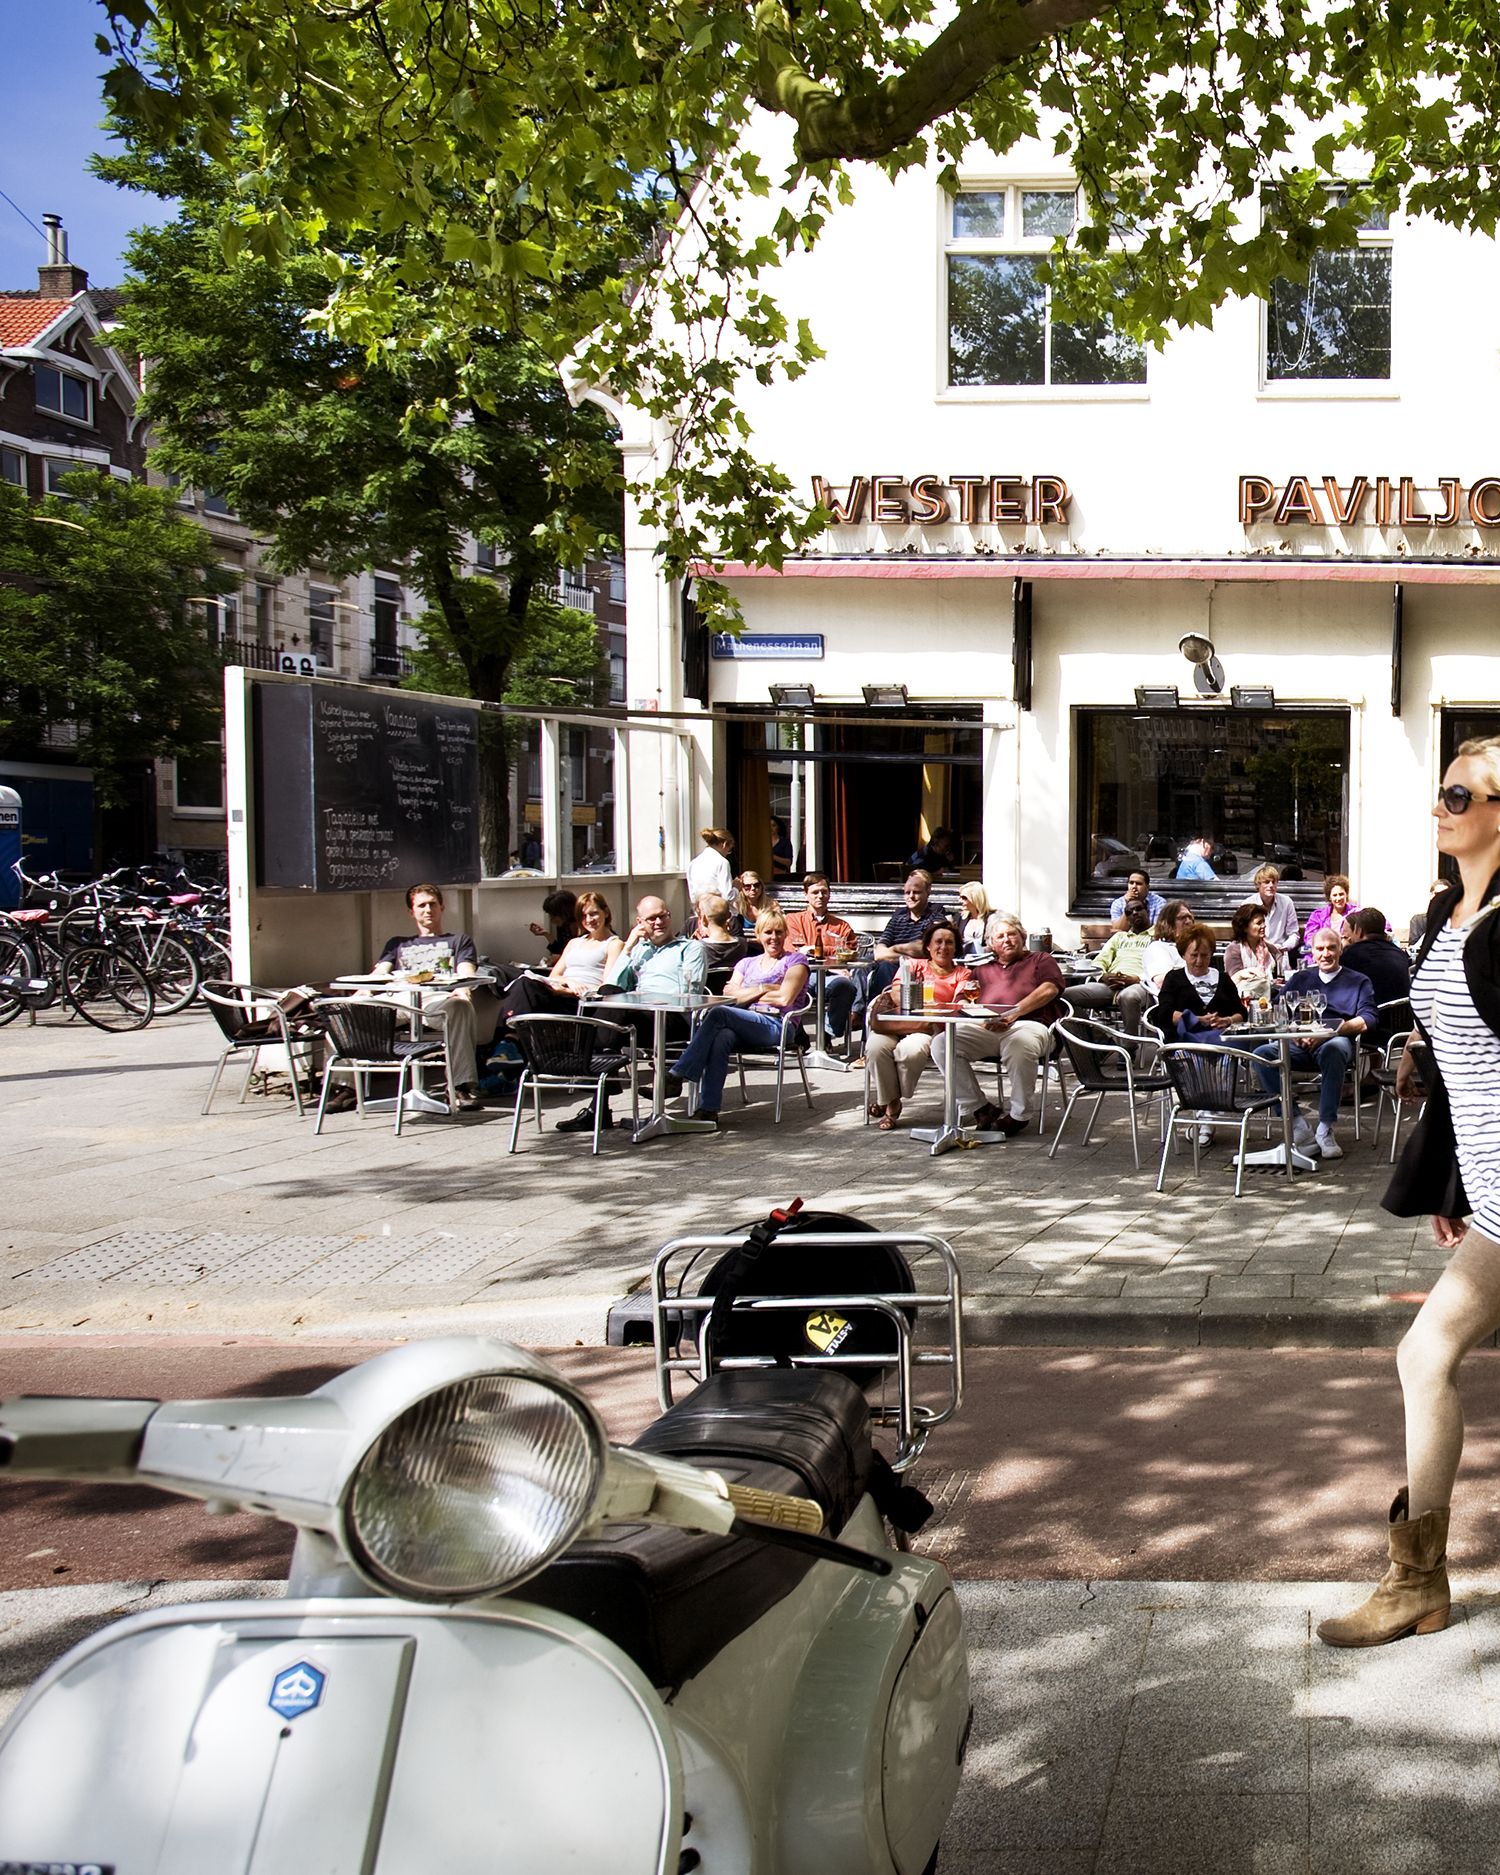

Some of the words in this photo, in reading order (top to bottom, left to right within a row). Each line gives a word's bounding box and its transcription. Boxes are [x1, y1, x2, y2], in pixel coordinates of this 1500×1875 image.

[811, 475, 1073, 524] WESTER
[716, 640, 818, 651] Mathenesserlaan
[825, 1322, 853, 1356] A-STYLE
